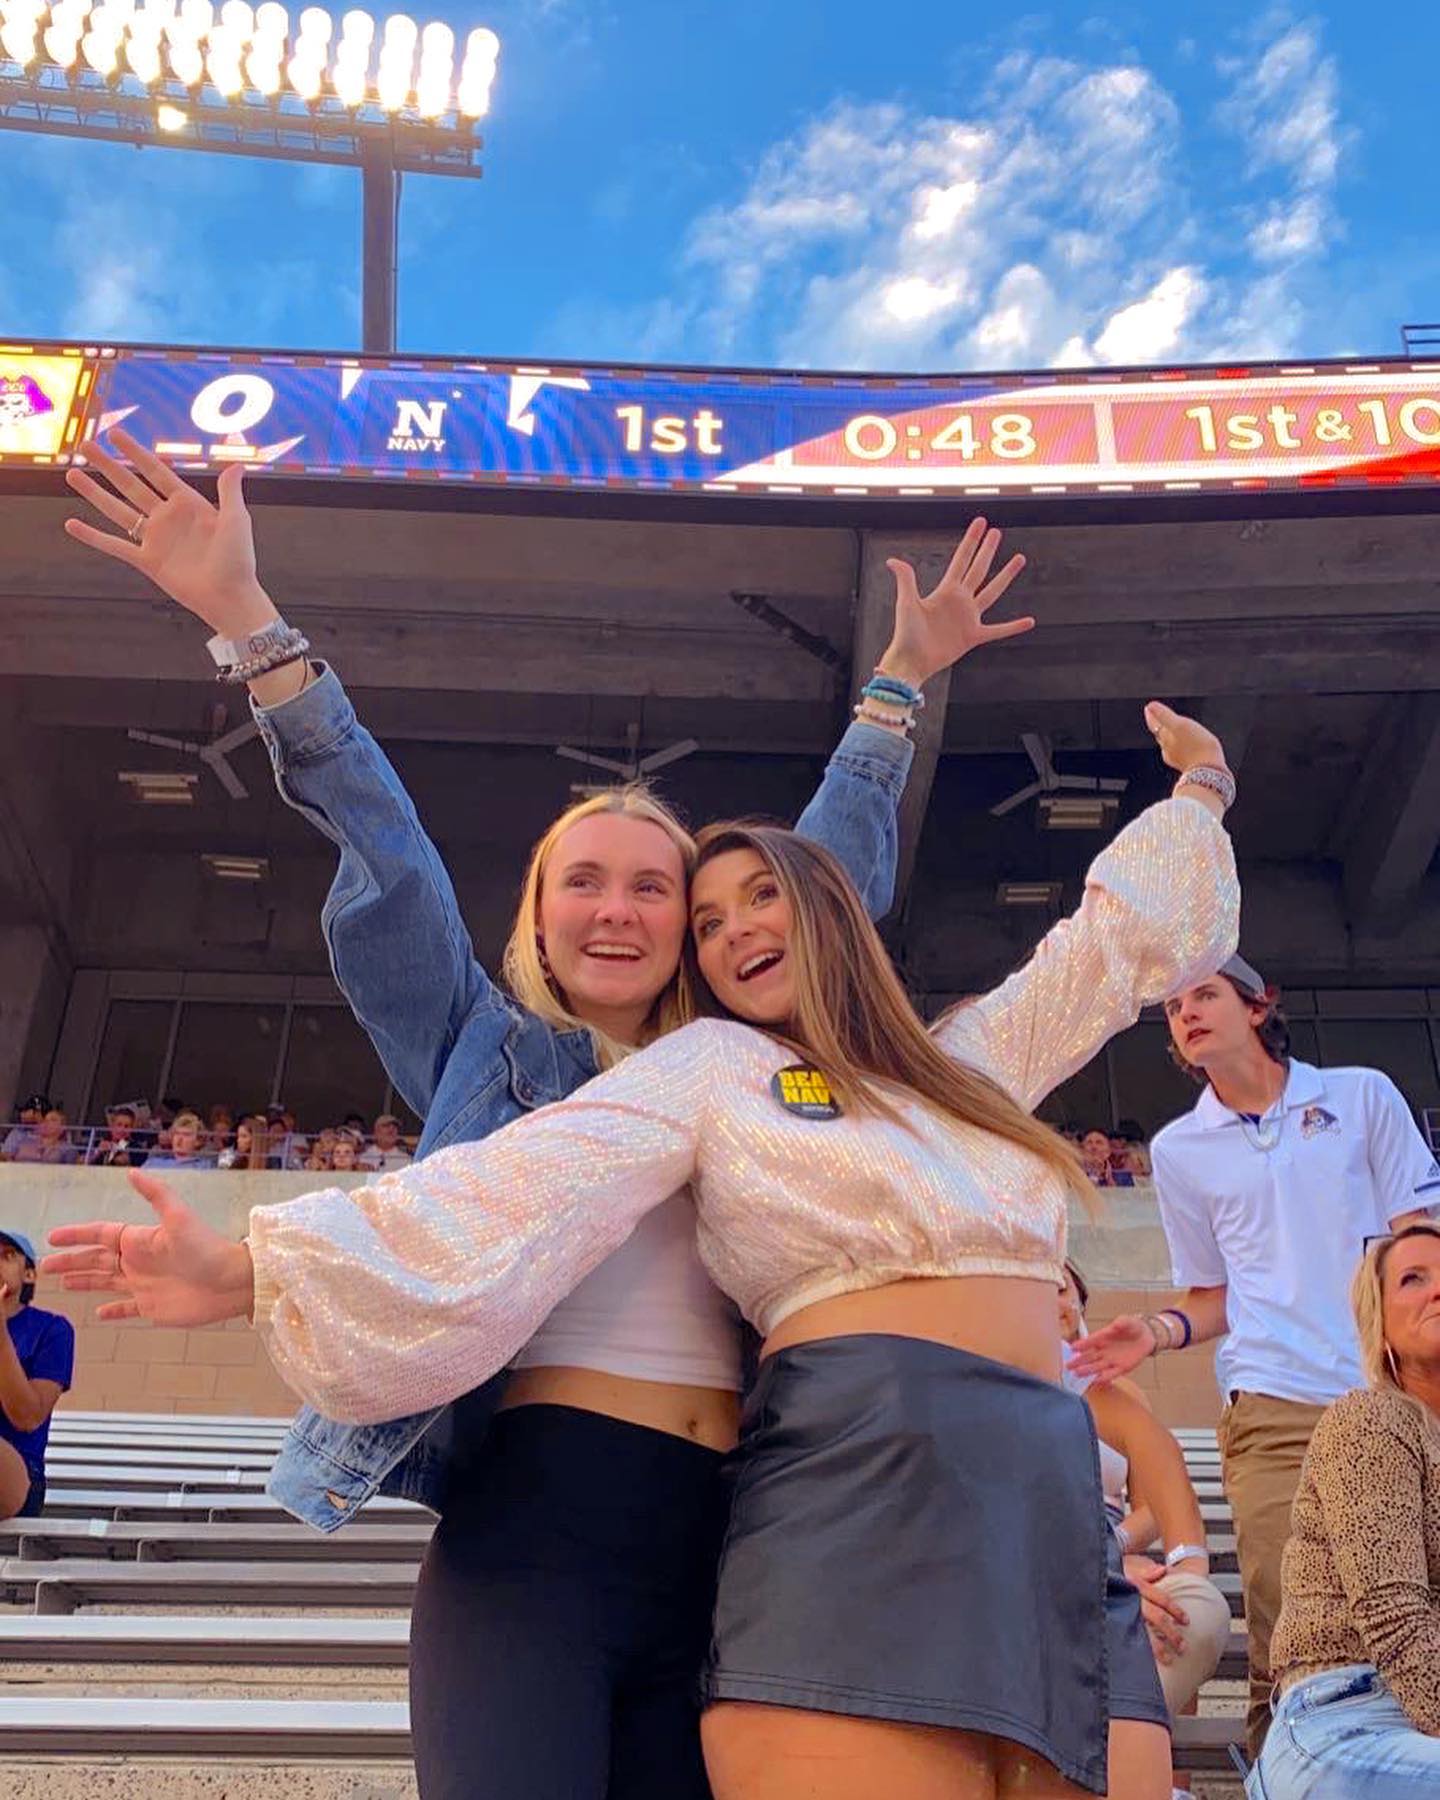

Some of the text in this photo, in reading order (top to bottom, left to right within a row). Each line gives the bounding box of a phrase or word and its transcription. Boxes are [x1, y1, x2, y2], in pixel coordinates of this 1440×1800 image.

[387, 437, 446, 452] NAVY
[616, 405, 724, 455] 1st
[843, 413, 1038, 461] 0:48
